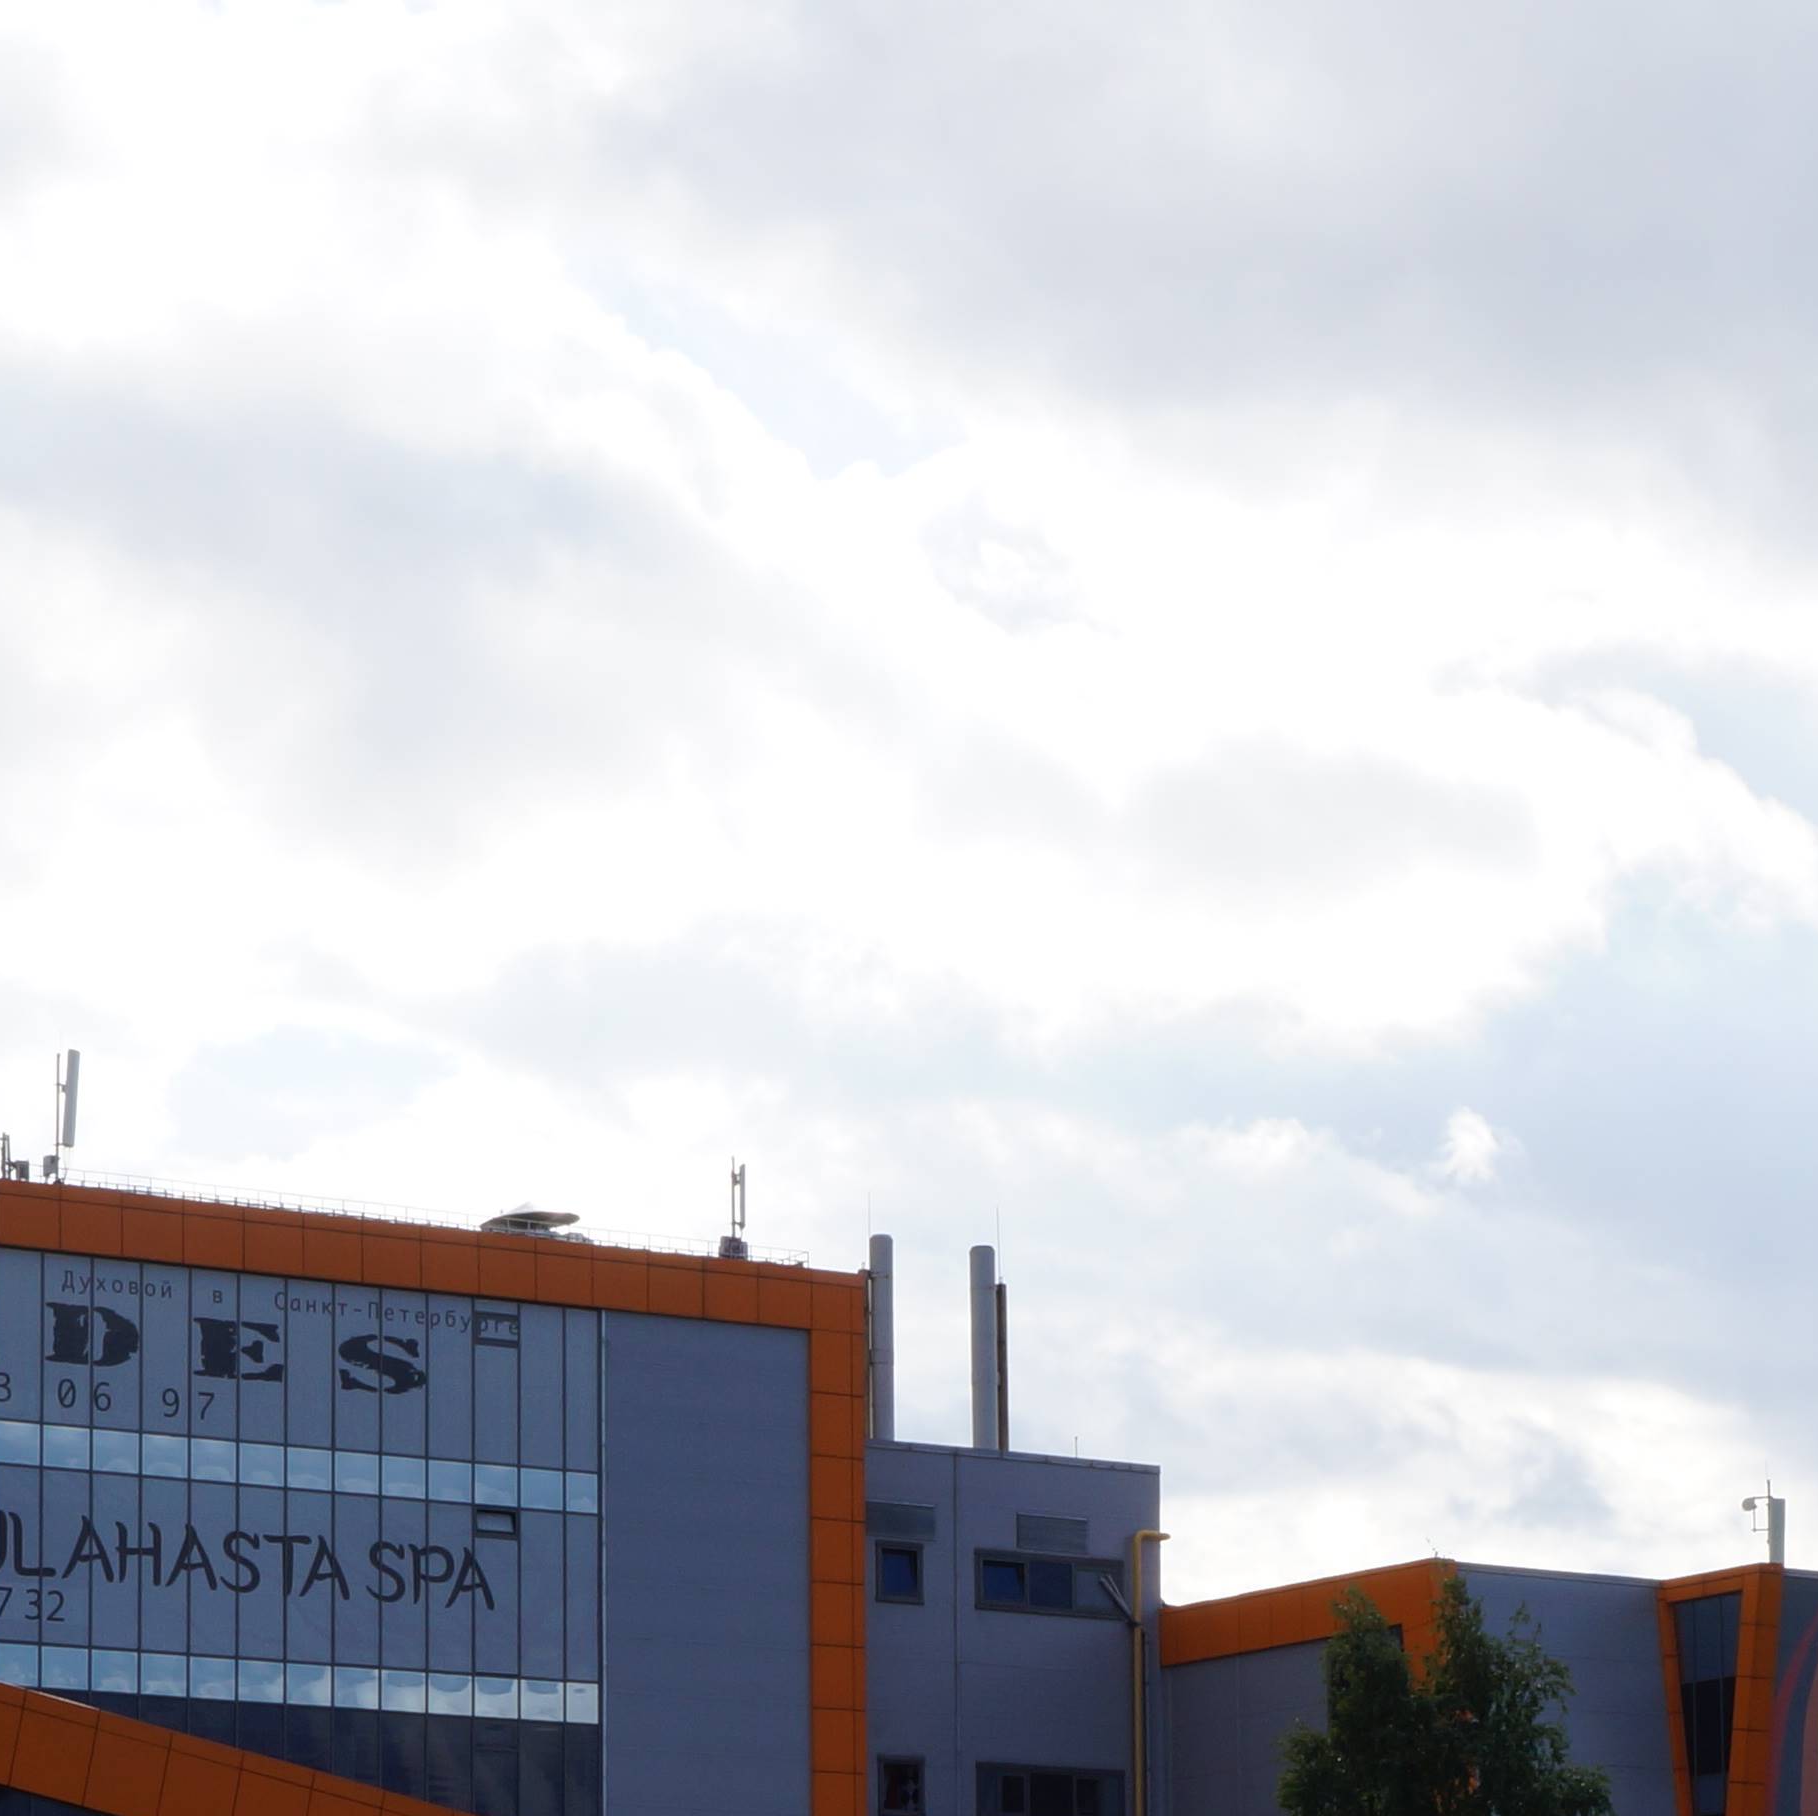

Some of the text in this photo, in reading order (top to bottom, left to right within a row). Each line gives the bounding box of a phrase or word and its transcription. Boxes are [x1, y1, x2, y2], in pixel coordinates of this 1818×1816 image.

[61, 1270, 173, 1299] Духовой
[212, 1290, 223, 1304] в
[274, 1291, 520, 1335] Санкт-Петербурге
[57, 1378, 112, 1412] 06
[161, 1388, 215, 1420] 97
[366, 1540, 496, 1610] SPA
[24, 1589, 65, 1622] 32
